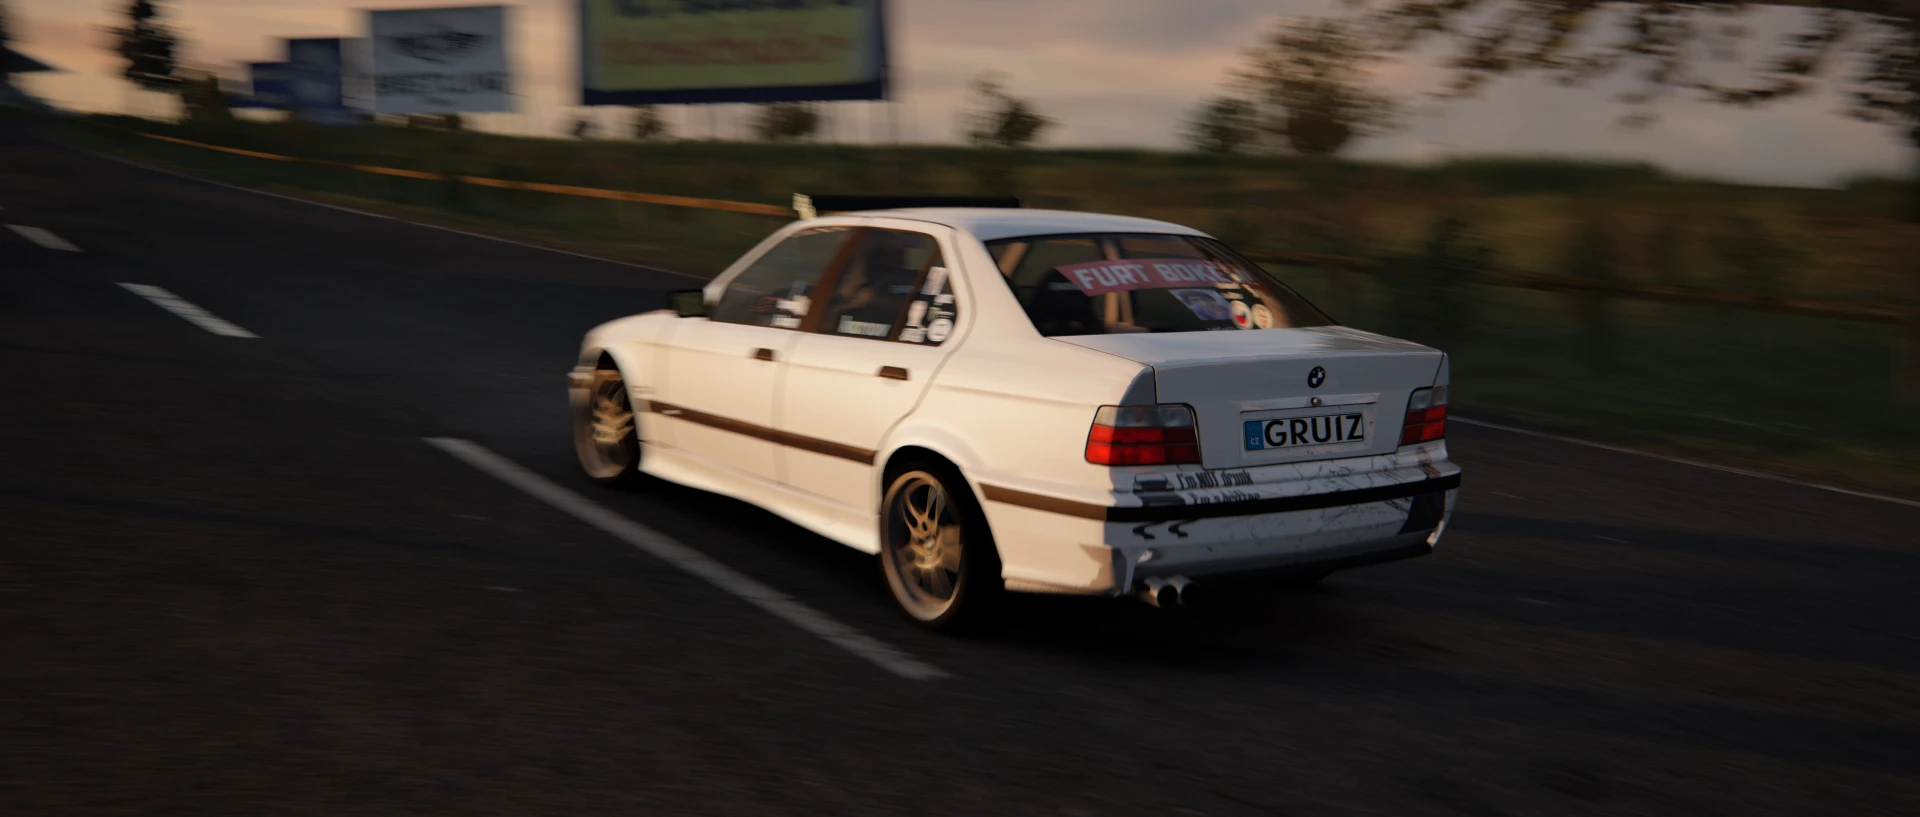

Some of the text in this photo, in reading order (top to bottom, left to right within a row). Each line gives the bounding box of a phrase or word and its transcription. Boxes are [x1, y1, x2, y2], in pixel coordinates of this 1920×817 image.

[1072, 264, 1149, 290] FURT
[1265, 414, 1364, 446] GRUIZ
[1196, 471, 1219, 488] NOT
[1220, 469, 1253, 486] drunk
